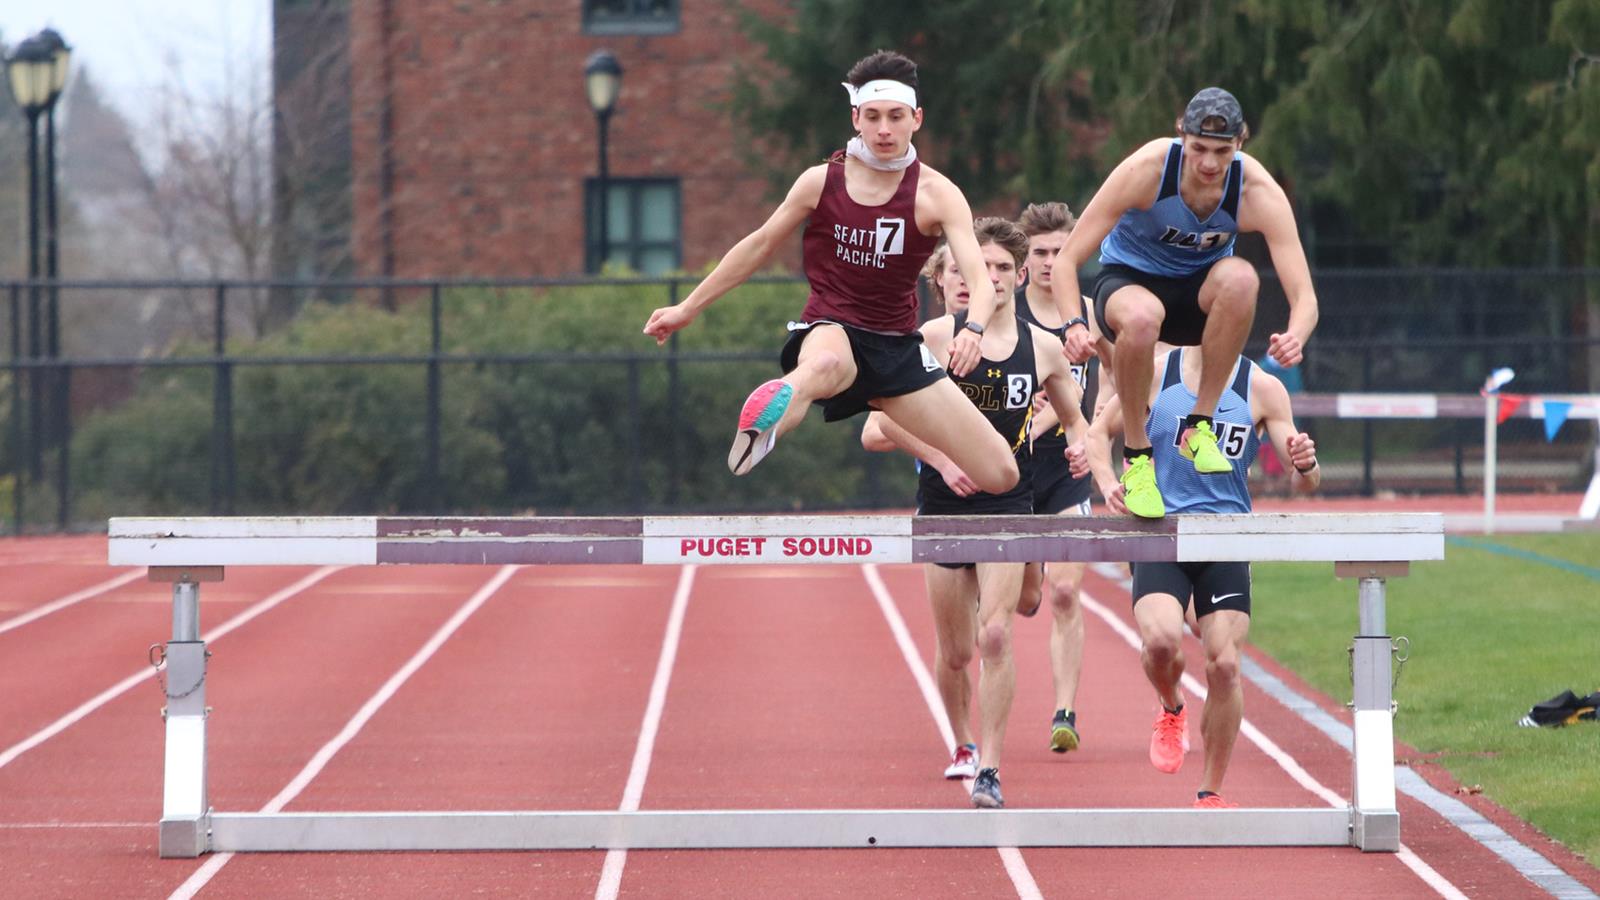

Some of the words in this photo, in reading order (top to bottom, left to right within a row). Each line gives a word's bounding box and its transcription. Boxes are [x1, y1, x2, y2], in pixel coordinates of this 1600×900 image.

[834, 224, 876, 248] SEATT
[880, 222, 901, 252] 7
[836, 243, 886, 269] PACIFIC
[1010, 377, 1028, 406] 3
[1225, 425, 1247, 457] 5
[680, 537, 766, 556] PUGET
[782, 537, 873, 556] SOUND
